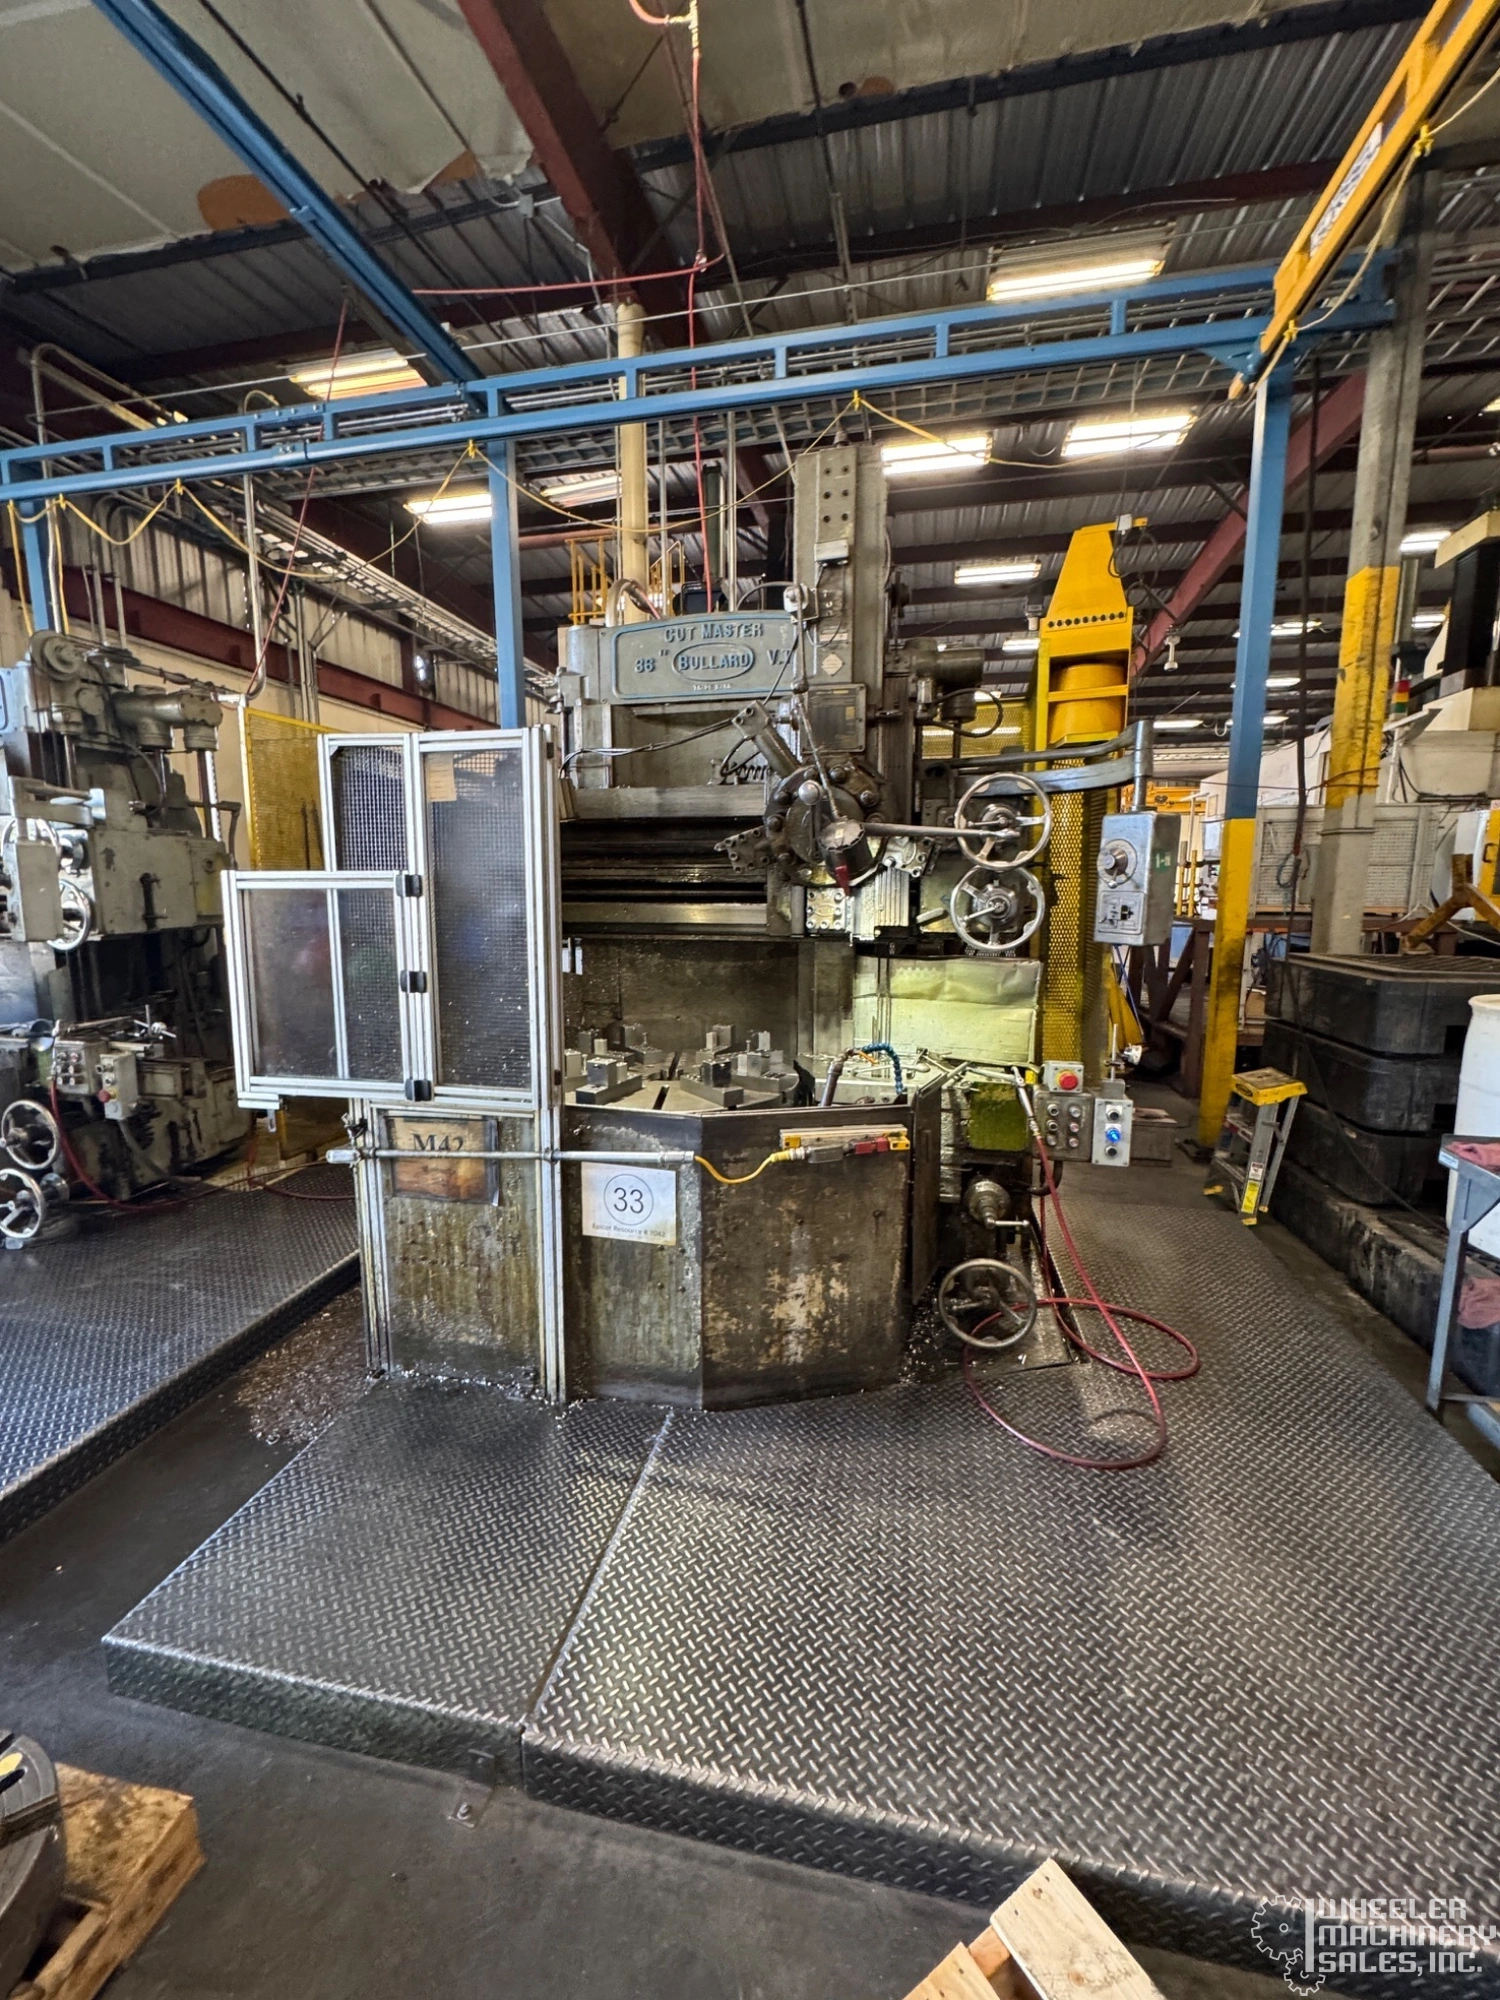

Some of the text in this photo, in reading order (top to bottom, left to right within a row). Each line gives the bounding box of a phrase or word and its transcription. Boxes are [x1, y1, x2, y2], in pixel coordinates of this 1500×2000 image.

[663, 624, 696, 643] CUT
[702, 622, 765, 639] MASTER
[677, 652, 750, 672] BULLARD
[613, 1186, 645, 1214] 33
